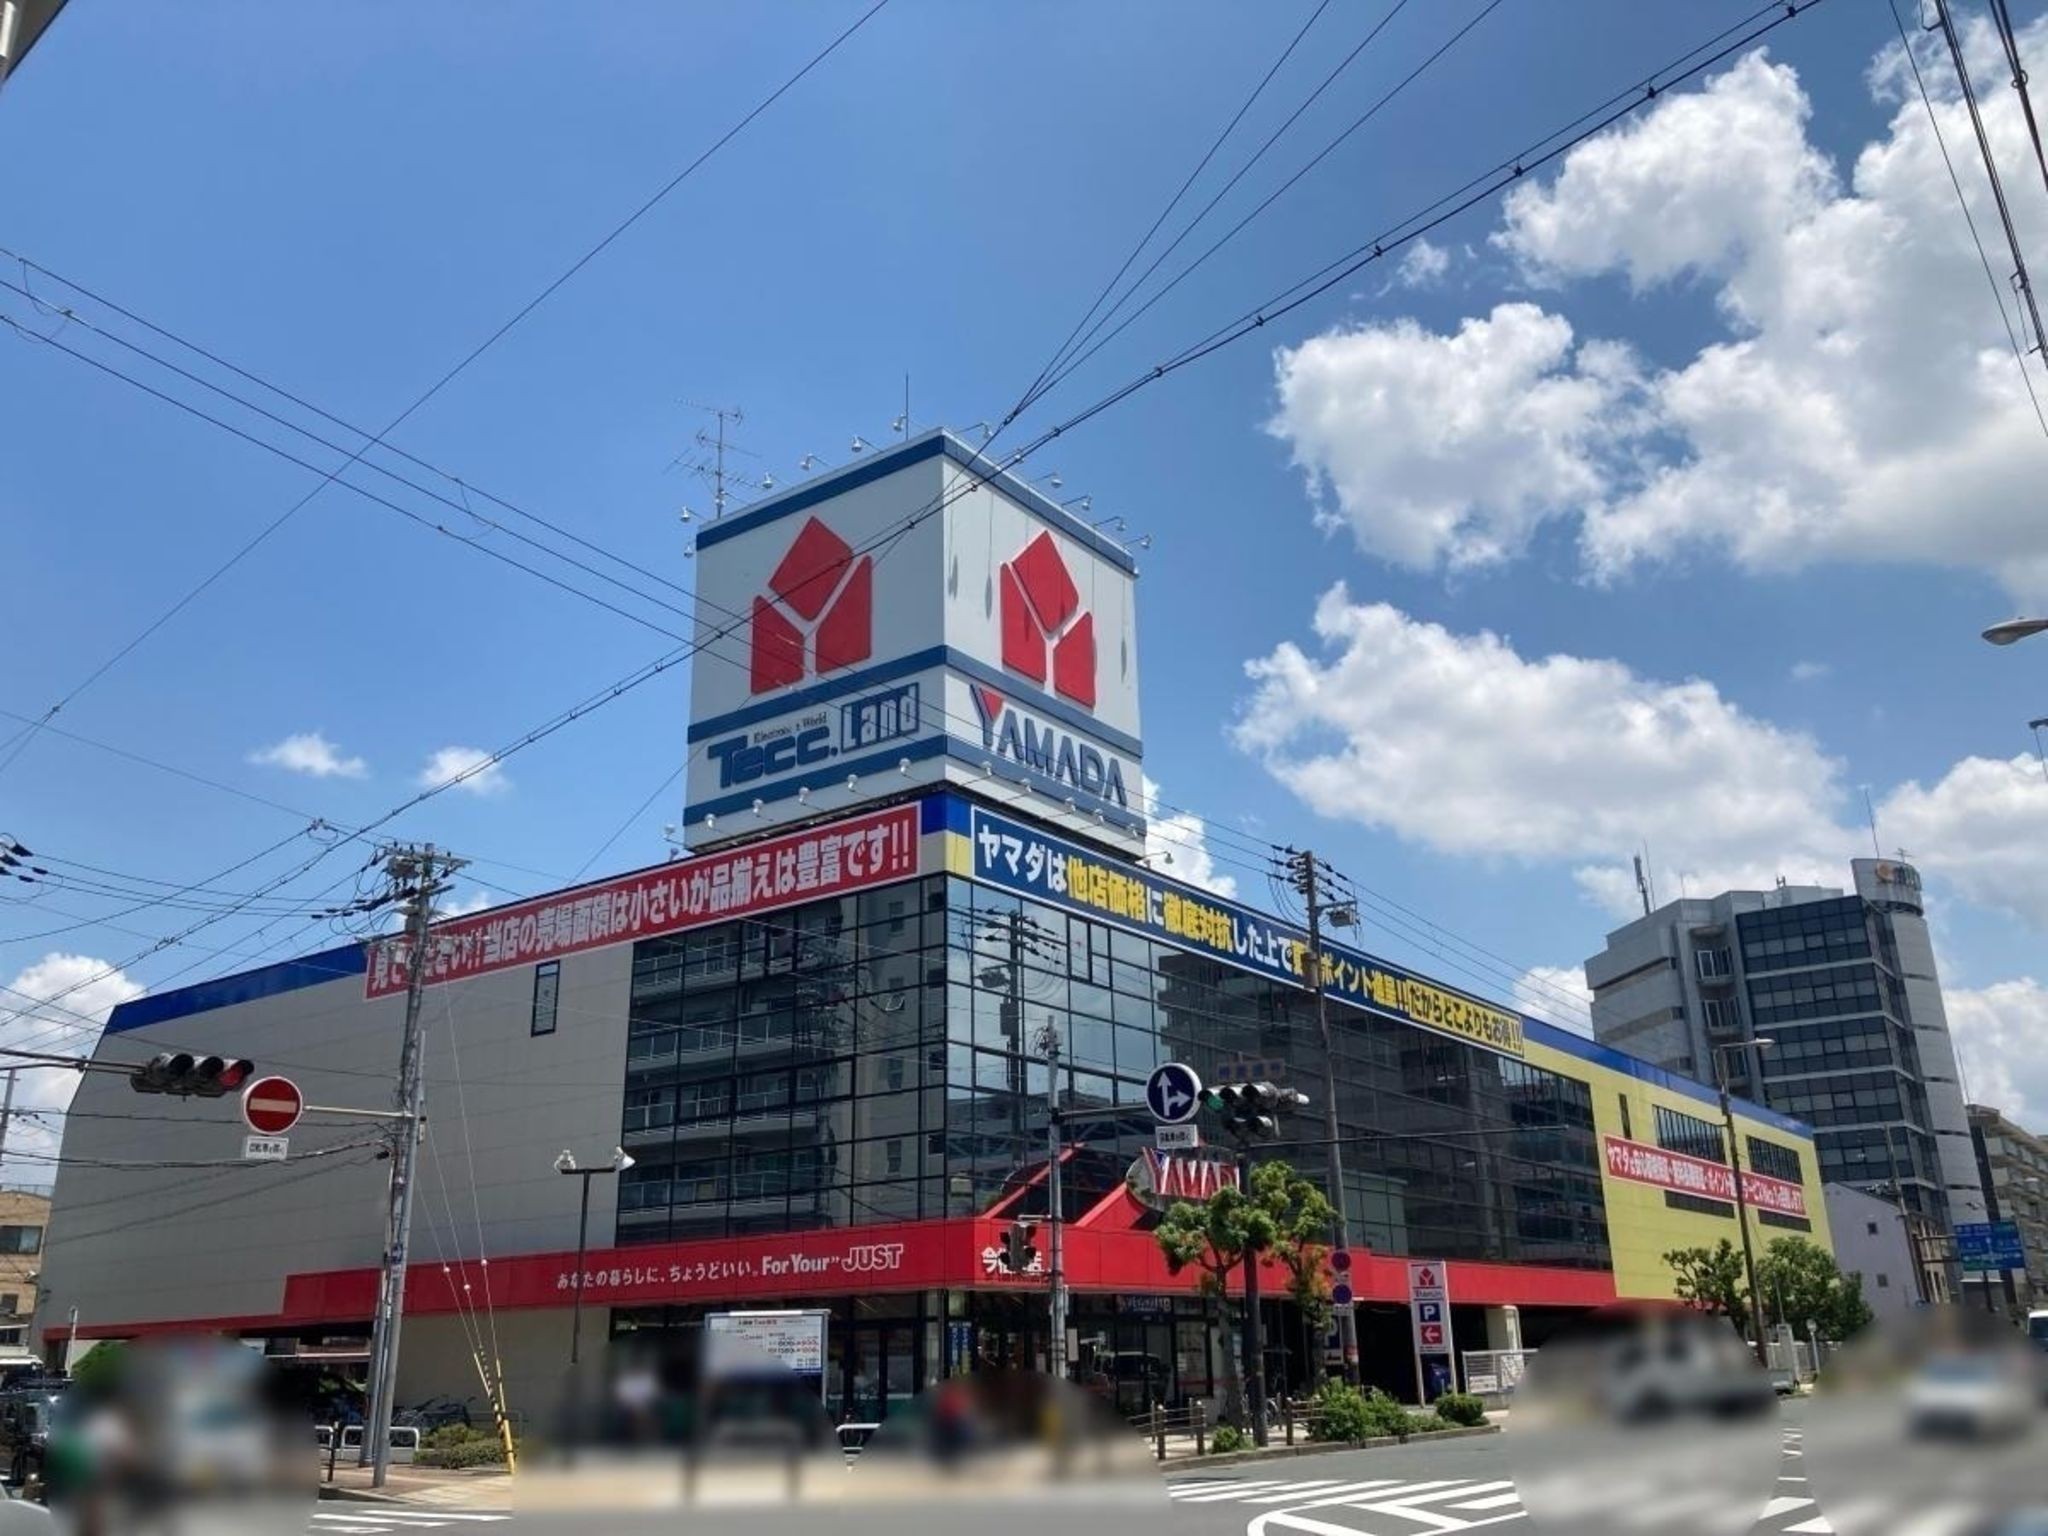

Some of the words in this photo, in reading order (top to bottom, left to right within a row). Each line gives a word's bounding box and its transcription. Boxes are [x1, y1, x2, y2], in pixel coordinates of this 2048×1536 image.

[969, 683, 1128, 807] YAMADA
[1142, 1146, 1240, 1200] YAMAD
[762, 1256, 789, 1276] For
[842, 1244, 903, 1272] JUST
[1423, 1305, 1436, 1321] P
